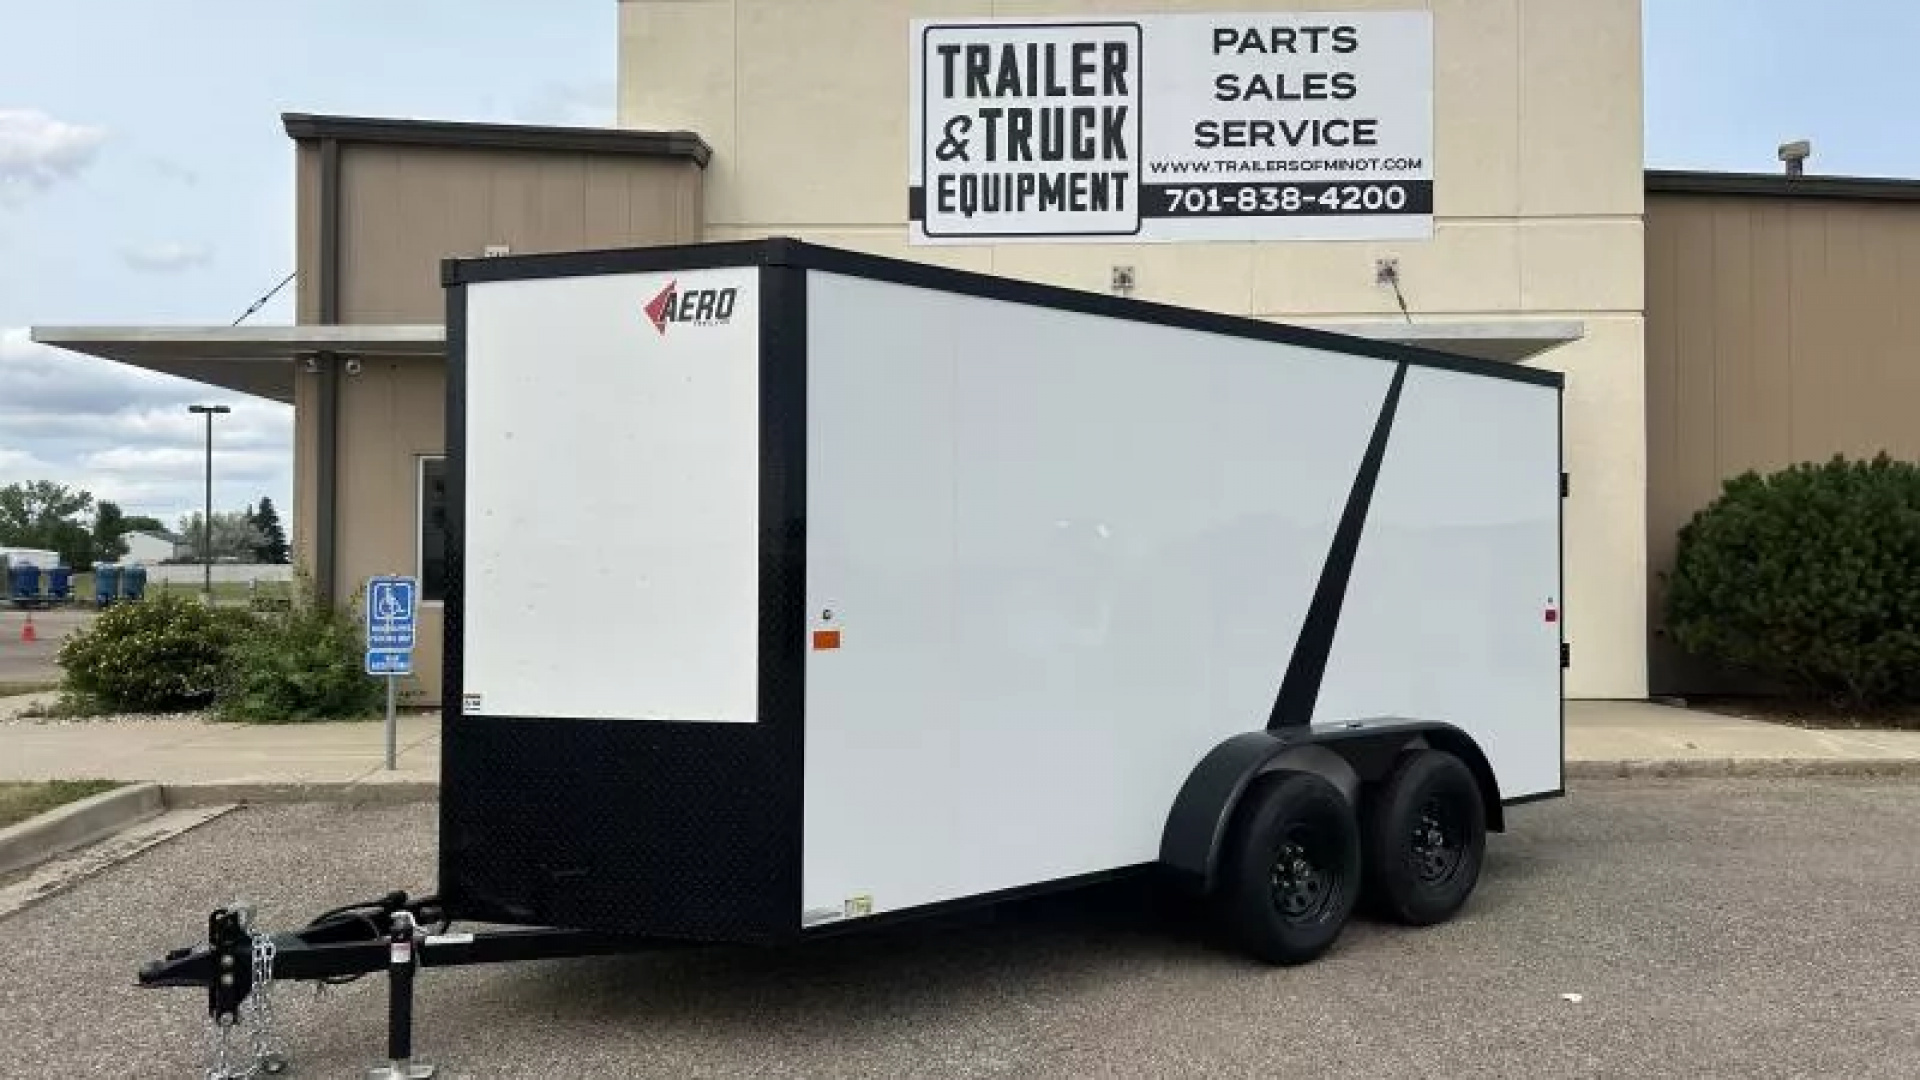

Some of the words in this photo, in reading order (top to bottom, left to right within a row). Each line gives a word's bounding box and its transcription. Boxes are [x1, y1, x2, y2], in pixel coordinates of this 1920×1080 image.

[1213, 26, 1358, 54] PARTS
[937, 42, 1129, 98] TRAILER
[1215, 72, 1357, 101] SALES
[979, 105, 1128, 162] TRUCK
[1195, 118, 1378, 147] SERVICE
[1150, 158, 1422, 174] WWW.TRAILERSOFMINOT.COM
[938, 172, 1129, 218] EQUIPMENT
[1165, 186, 1406, 212] 701-838-4200
[661, 287, 738, 322] AERO
